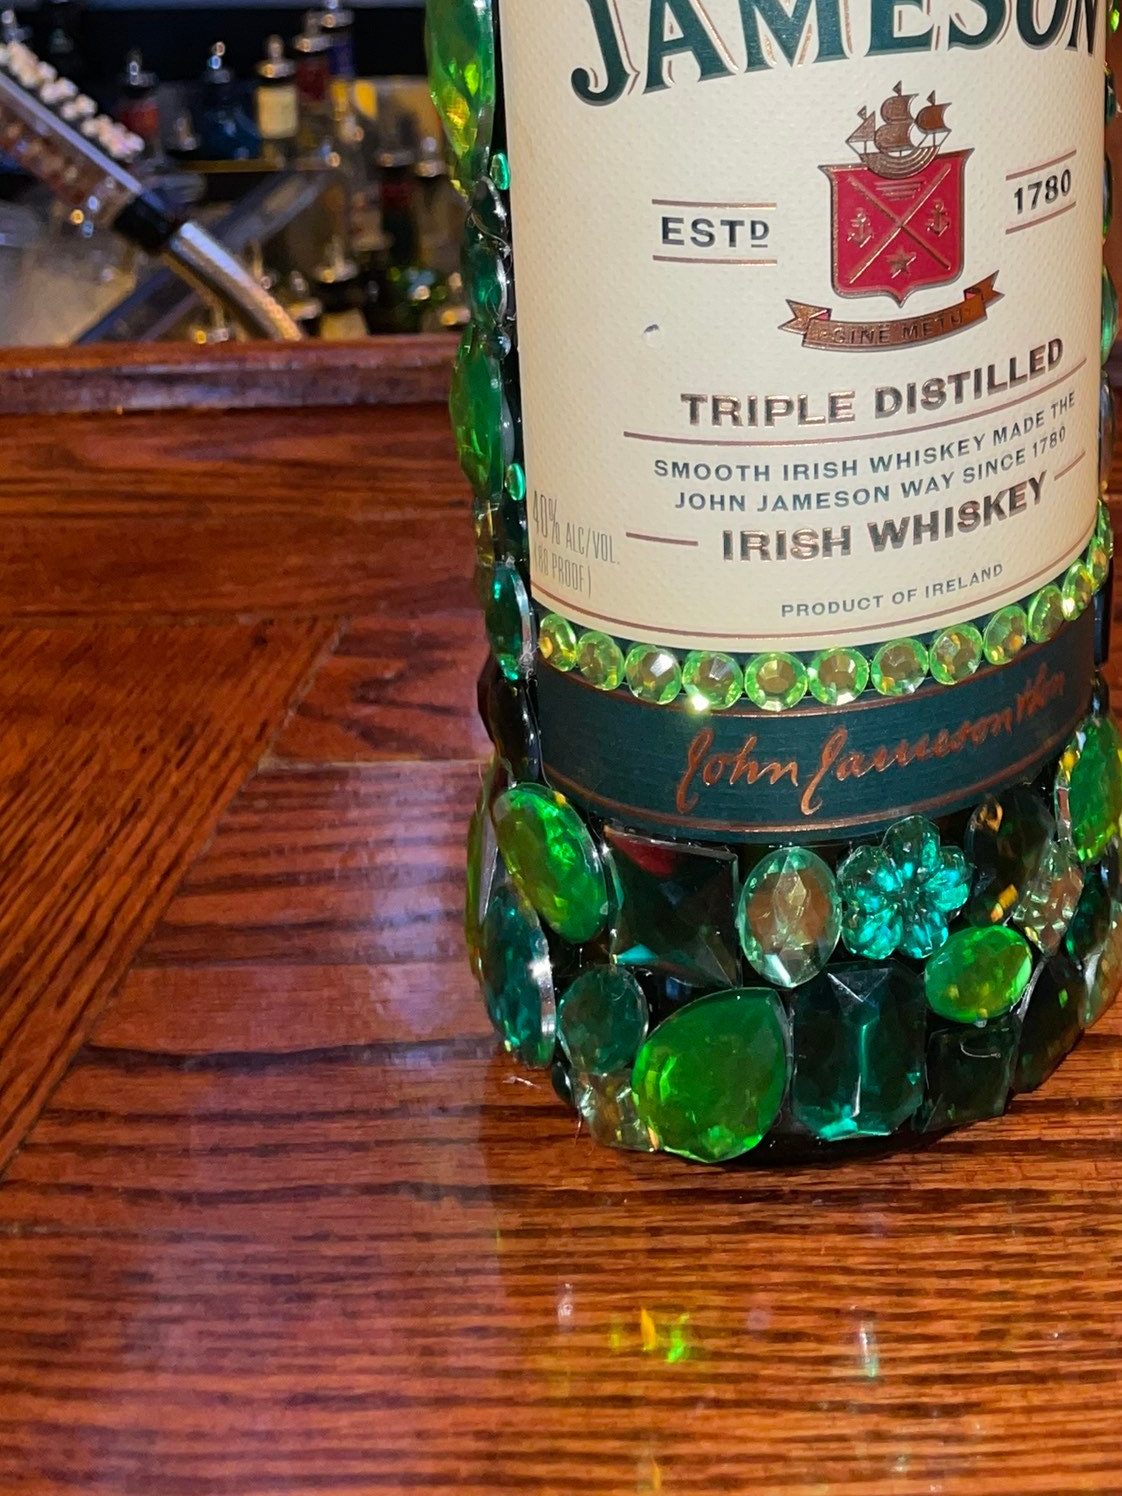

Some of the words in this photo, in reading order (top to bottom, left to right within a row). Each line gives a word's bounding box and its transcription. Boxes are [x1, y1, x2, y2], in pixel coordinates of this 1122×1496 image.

[1013, 167, 1072, 215] 1780
[903, 310, 964, 341] METU
[680, 390, 855, 427] TRIPLE
[874, 338, 1063, 419] DISTILLED
[654, 459, 770, 482] SMOOTH
[783, 459, 858, 481] IRISH
[869, 433, 985, 473] WHISKEY
[993, 410, 1044, 446] MADE
[1050, 391, 1075, 418] THE
[675, 492, 745, 512] JOHN
[757, 485, 890, 512] JAMESON
[900, 471, 954, 498] WAY
[962, 447, 1026, 484] SINCE
[1032, 425, 1066, 457] 1780
[532, 490, 560, 545] 40%
[723, 525, 851, 562] IRISH
[866, 470, 1048, 552] WHISKEY
[552, 553, 592, 600] PROOF)
[781, 595, 883, 618] PRODUCT
[892, 589, 918, 605] OF
[925, 563, 1004, 599] IRELAND
[676, 727, 799, 815] John
